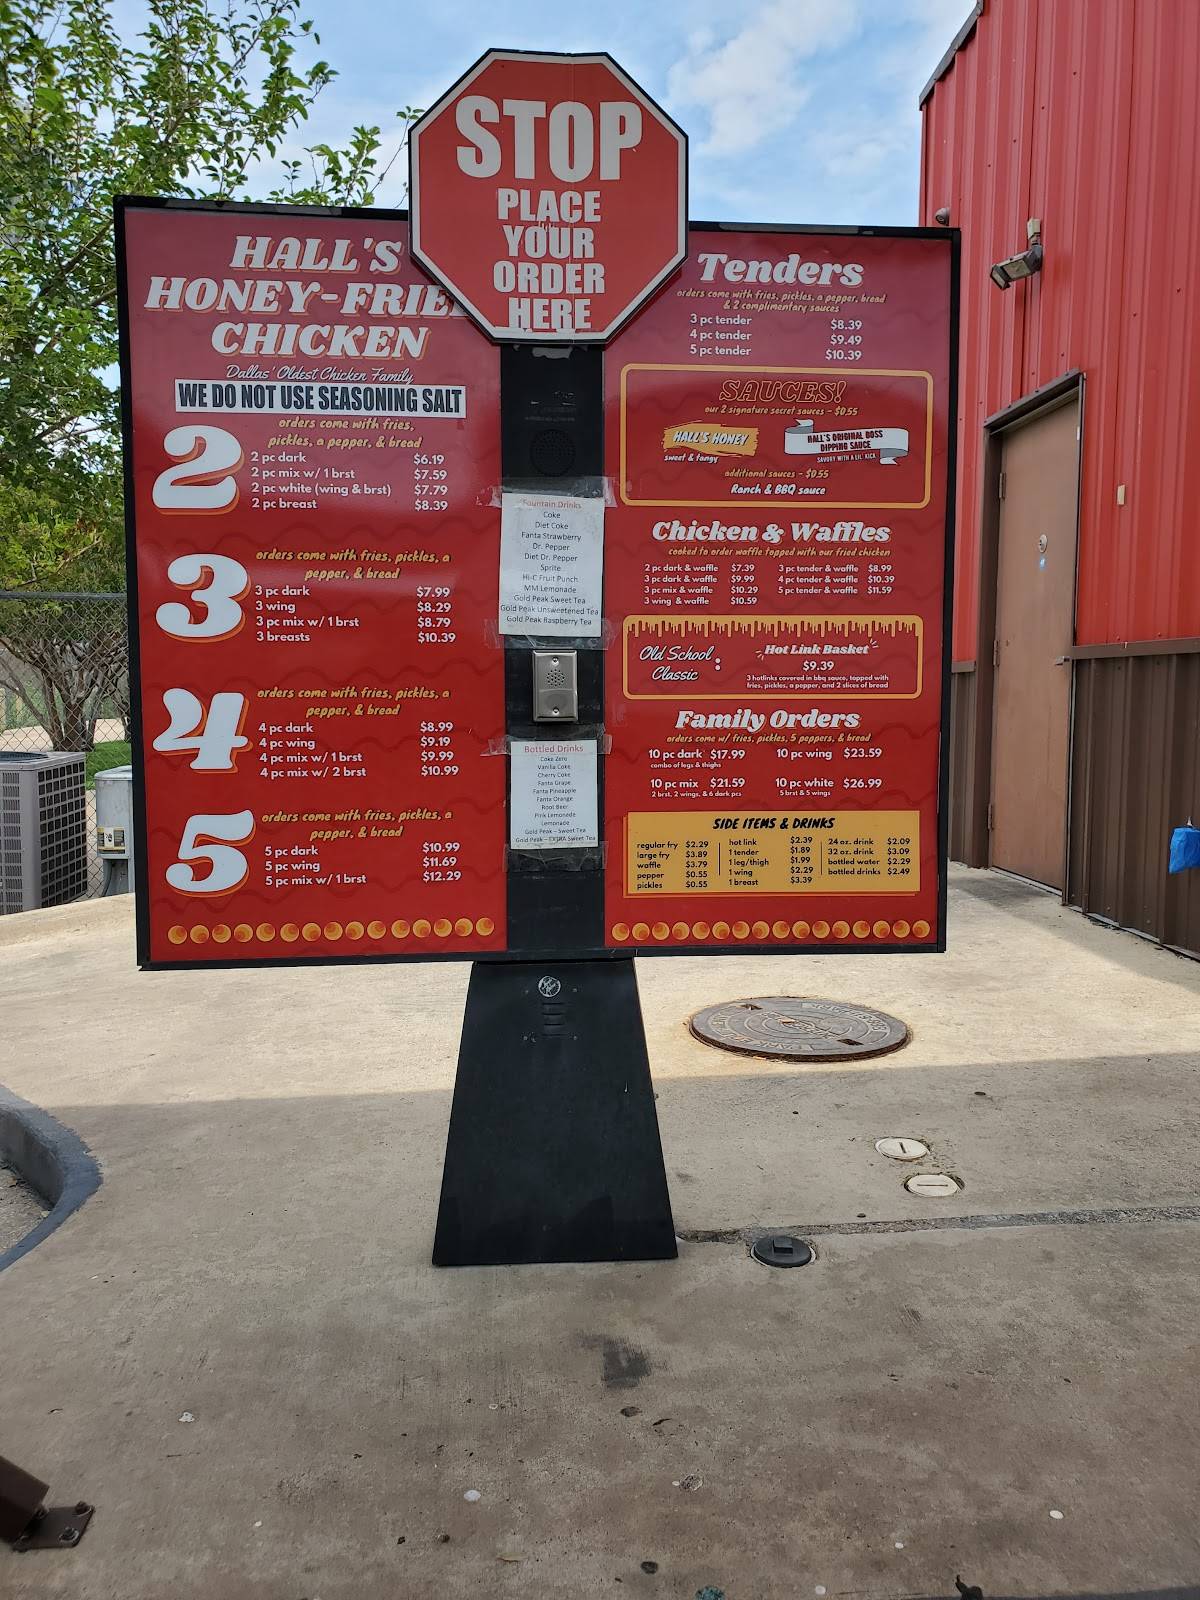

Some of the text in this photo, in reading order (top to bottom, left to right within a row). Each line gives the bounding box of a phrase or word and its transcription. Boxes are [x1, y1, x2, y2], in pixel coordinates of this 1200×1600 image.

[456, 95, 642, 182] STOP
[498, 188, 601, 223] PLACE
[503, 225, 594, 259] YOUR
[229, 235, 401, 273] HALL'S
[493, 260, 605, 294] ORDER
[698, 253, 864, 287] Tenders
[508, 297, 591, 329] HERE
[690, 314, 862, 330] 3 pc tender $8.39
[211, 322, 429, 359] CHICKEN
[690, 345, 862, 360] 5 pc tender $10.39
[226, 365, 414, 384] Dallas' Oldest Chicken Family
[179, 383, 462, 412] WE DO NOT USE SEASONING SALT
[719, 380, 847, 403] SAUCES!
[279, 418, 415, 431] orders come with fries,
[268, 435, 312, 448] pickles,
[327, 438, 372, 449] pepper,
[376, 437, 385, 448] &
[388, 436, 422, 449] bread
[673, 431, 748, 446] HALL'S HONEY
[251, 452, 444, 466] 2 pc dark $6.19
[153, 425, 244, 513] 2
[251, 467, 447, 481] 2 pc mix w/ 1 brst $7.59
[731, 484, 761, 494] Ranch
[764, 484, 772, 494] &
[775, 484, 795, 495] BBQ
[252, 499, 448, 511] 2 pc breast $8.39
[557, 501, 581, 510] Drinks
[551, 522, 568, 530] Coke
[653, 521, 890, 543] Chicken & Waffles
[521, 531, 581, 542] Fanta Strawberry
[545, 543, 570, 552] Pepper
[540, 564, 561, 572] Sprite
[652, 566, 661, 574] pc
[663, 564, 682, 572] dark
[693, 564, 718, 572] waffle
[731, 564, 754, 572] $7.39
[255, 586, 450, 598] 3 pc dark $7.99
[540, 585, 576, 594] Lemonade
[156, 553, 250, 641] 3
[652, 598, 671, 606] wing
[684, 597, 709, 605] waffle
[730, 597, 757, 606] $10.59
[256, 601, 451, 614] 3 wing $8.29
[257, 631, 456, 644] 3 breasts $10.39
[640, 646, 714, 660] Old School
[765, 644, 869, 654] Hot Link Basket
[802, 660, 834, 671] $9.39
[653, 667, 698, 681] Classic
[676, 709, 860, 732] Family Orders
[153, 688, 253, 772] 4
[259, 737, 450, 750] 4 pc wing $9.19
[525, 745, 583, 753] Bottled Drinks
[649, 748, 745, 762] 10 pc dark $17.99
[777, 748, 881, 761] 10 pc wing $23.59
[713, 817, 835, 829] SIDE ITEMS & DRINKS
[637, 840, 709, 851] regular fry $2.29
[790, 836, 813, 844] $2.39
[166, 810, 256, 896] 5
[265, 842, 460, 858] 5 pc dark $10.99
[265, 857, 457, 873] 5 pc wing $11.69
[686, 860, 708, 869] $3.79
[887, 857, 910, 865] $2.29
[637, 871, 707, 880] pepper $0.55
[637, 880, 707, 890] pickles $0.55
